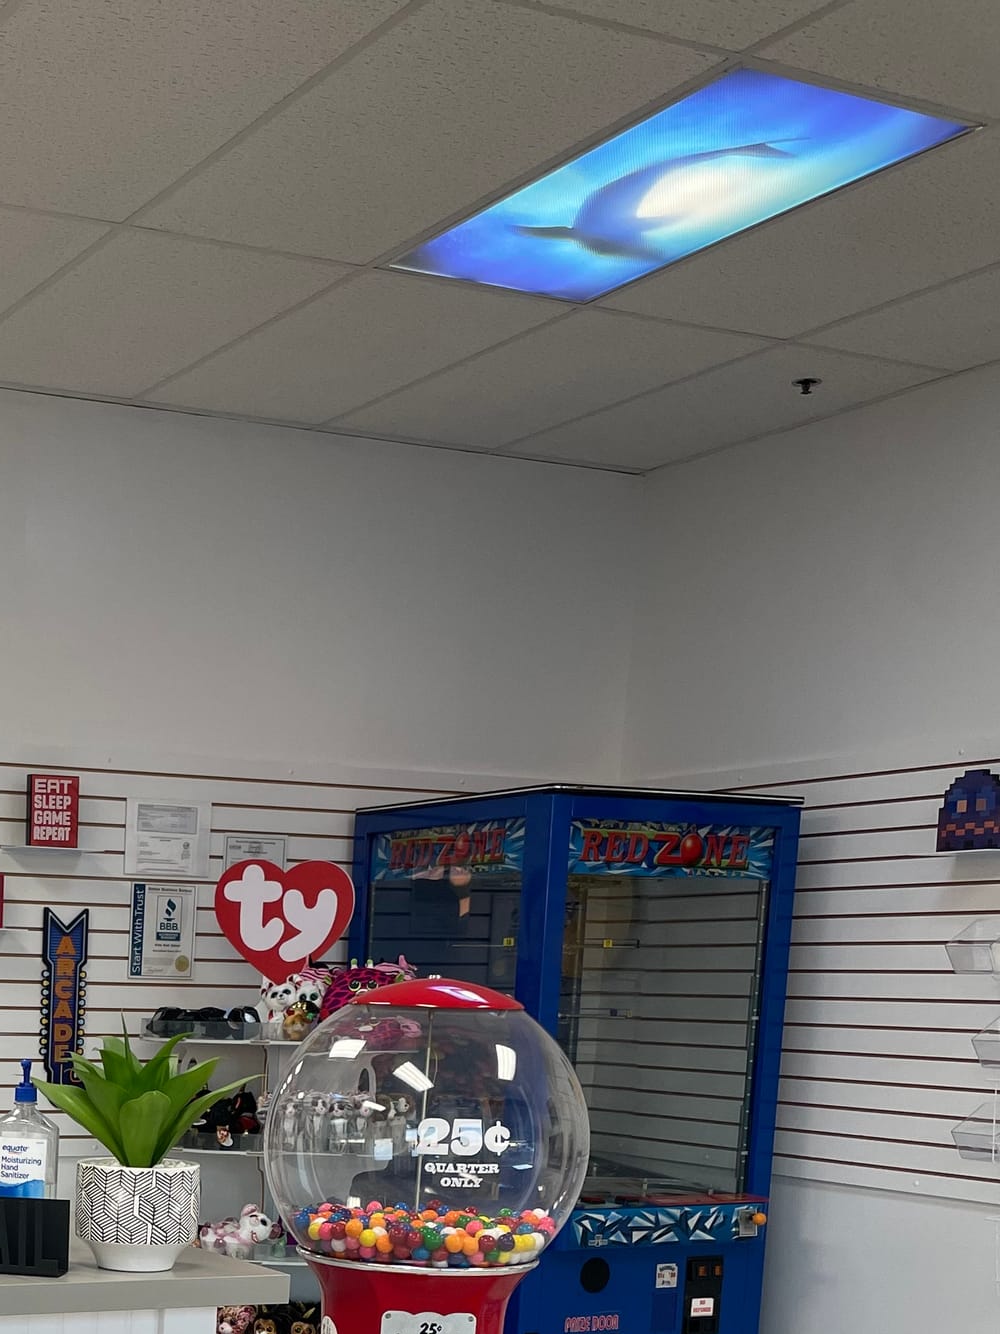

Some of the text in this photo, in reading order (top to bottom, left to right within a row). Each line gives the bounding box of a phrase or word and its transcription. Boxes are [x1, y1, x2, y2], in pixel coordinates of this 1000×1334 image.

[34, 778, 72, 794] EAT
[34, 794, 71, 810] SLEEP
[34, 810, 71, 825] GAME
[33, 826, 71, 841] REPEAT
[578, 829, 750, 868] RED ZONE
[223, 864, 338, 963] ty
[134, 918, 143, 944] With
[159, 922, 178, 931] BBB
[131, 946, 142, 973] Start
[53, 936, 77, 1063] ARCADE
[417, 1118, 511, 1156] 25¢
[1, 1156, 42, 1166] Moisturizing
[424, 1162, 500, 1174] QUARTER
[0, 1171, 30, 1179] Sanitizer
[440, 1177, 483, 1188] ONLY
[564, 1314, 619, 1333] PRIZE DOOR
